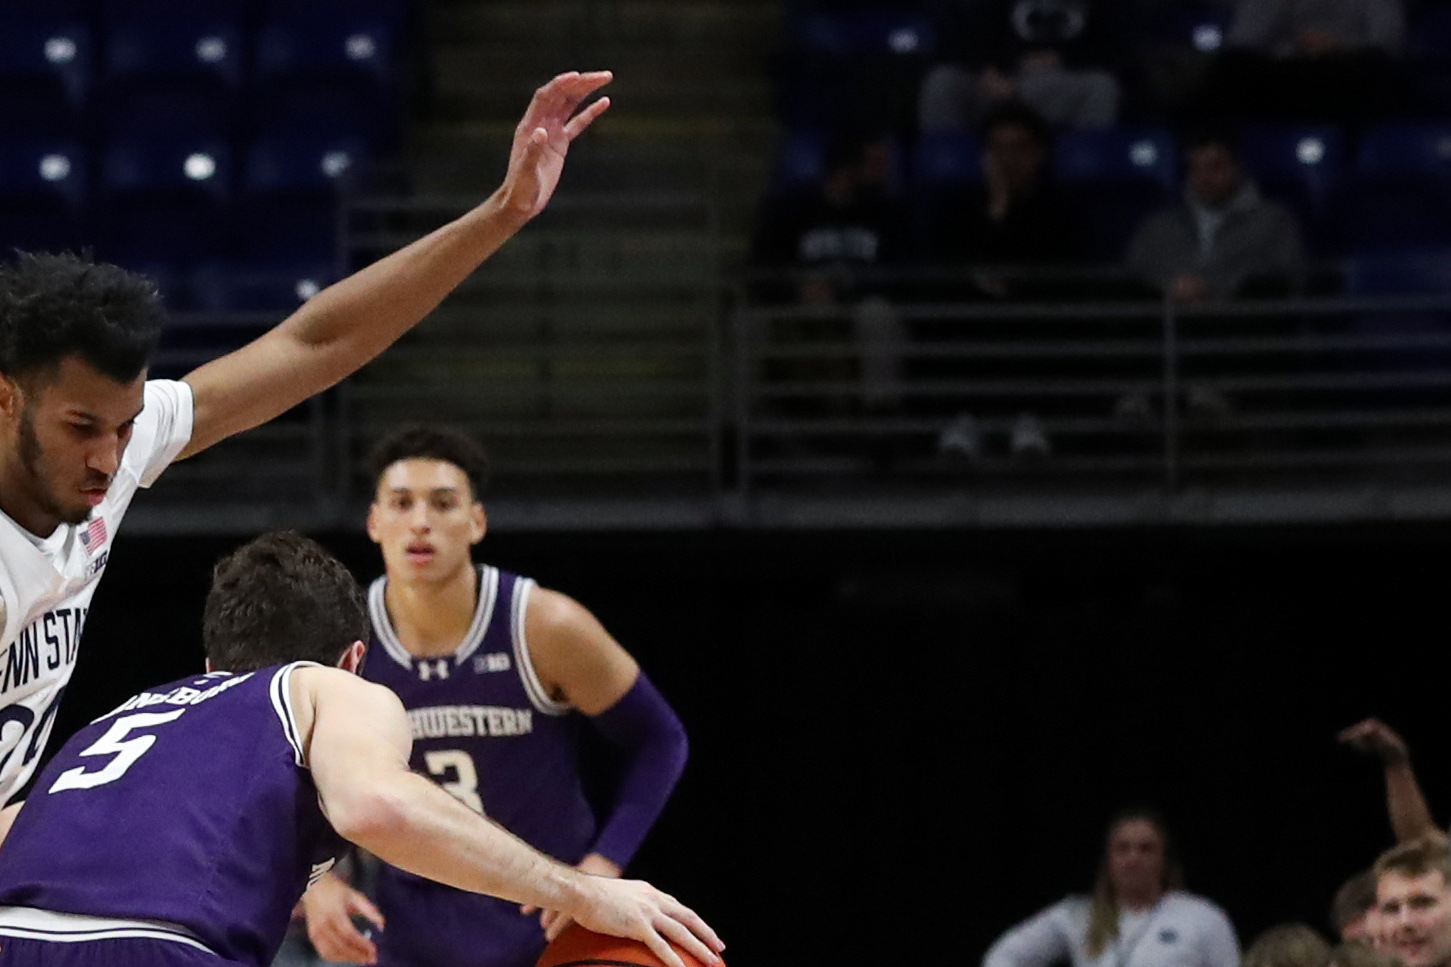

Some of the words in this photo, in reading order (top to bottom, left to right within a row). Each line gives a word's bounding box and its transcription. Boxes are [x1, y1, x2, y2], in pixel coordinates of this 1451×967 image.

[44, 607, 88, 670] STA
[48, 708, 186, 794] 5
[424, 749, 485, 817] 3
